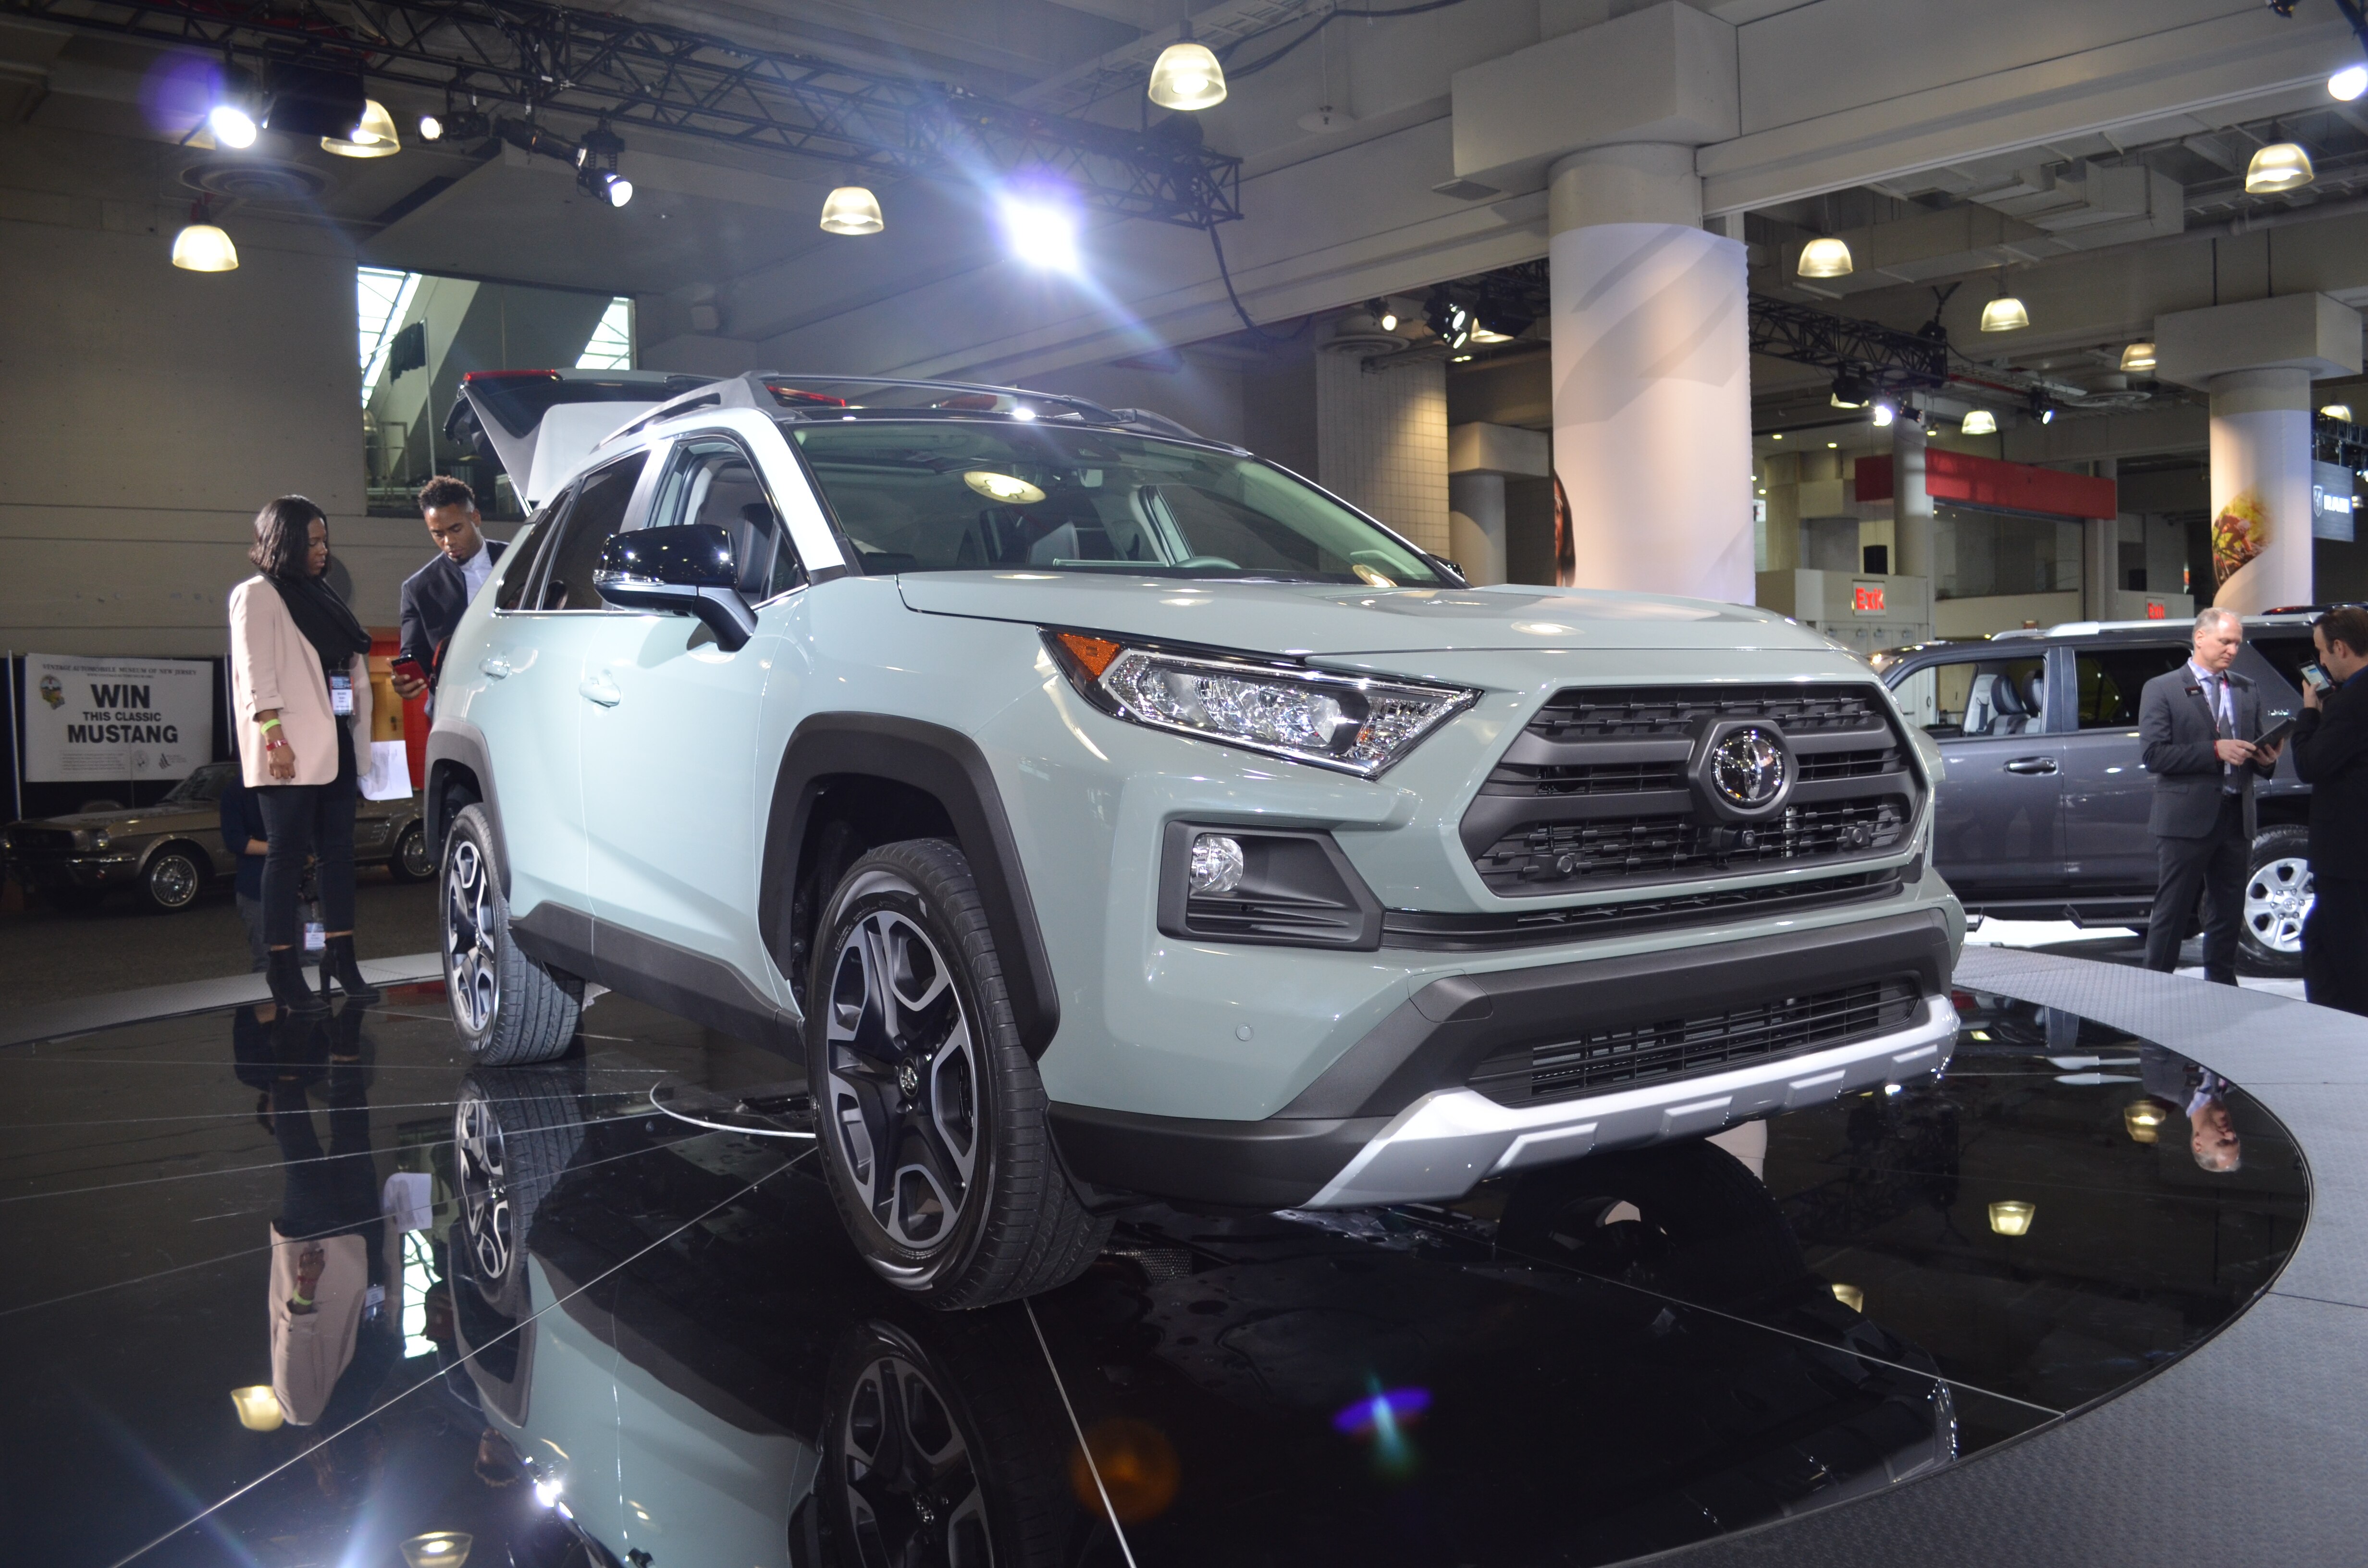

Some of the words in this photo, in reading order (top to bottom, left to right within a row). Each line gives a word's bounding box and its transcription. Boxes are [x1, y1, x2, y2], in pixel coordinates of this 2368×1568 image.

[2323, 495, 2349, 514] RAM
[1856, 588, 1884, 610] Exit
[2148, 602, 2165, 619] Exit
[90, 684, 150, 709] WIN
[83, 712, 111, 721] THIS
[115, 712, 161, 722] CLASSIC
[67, 724, 178, 743] MUSTANG
